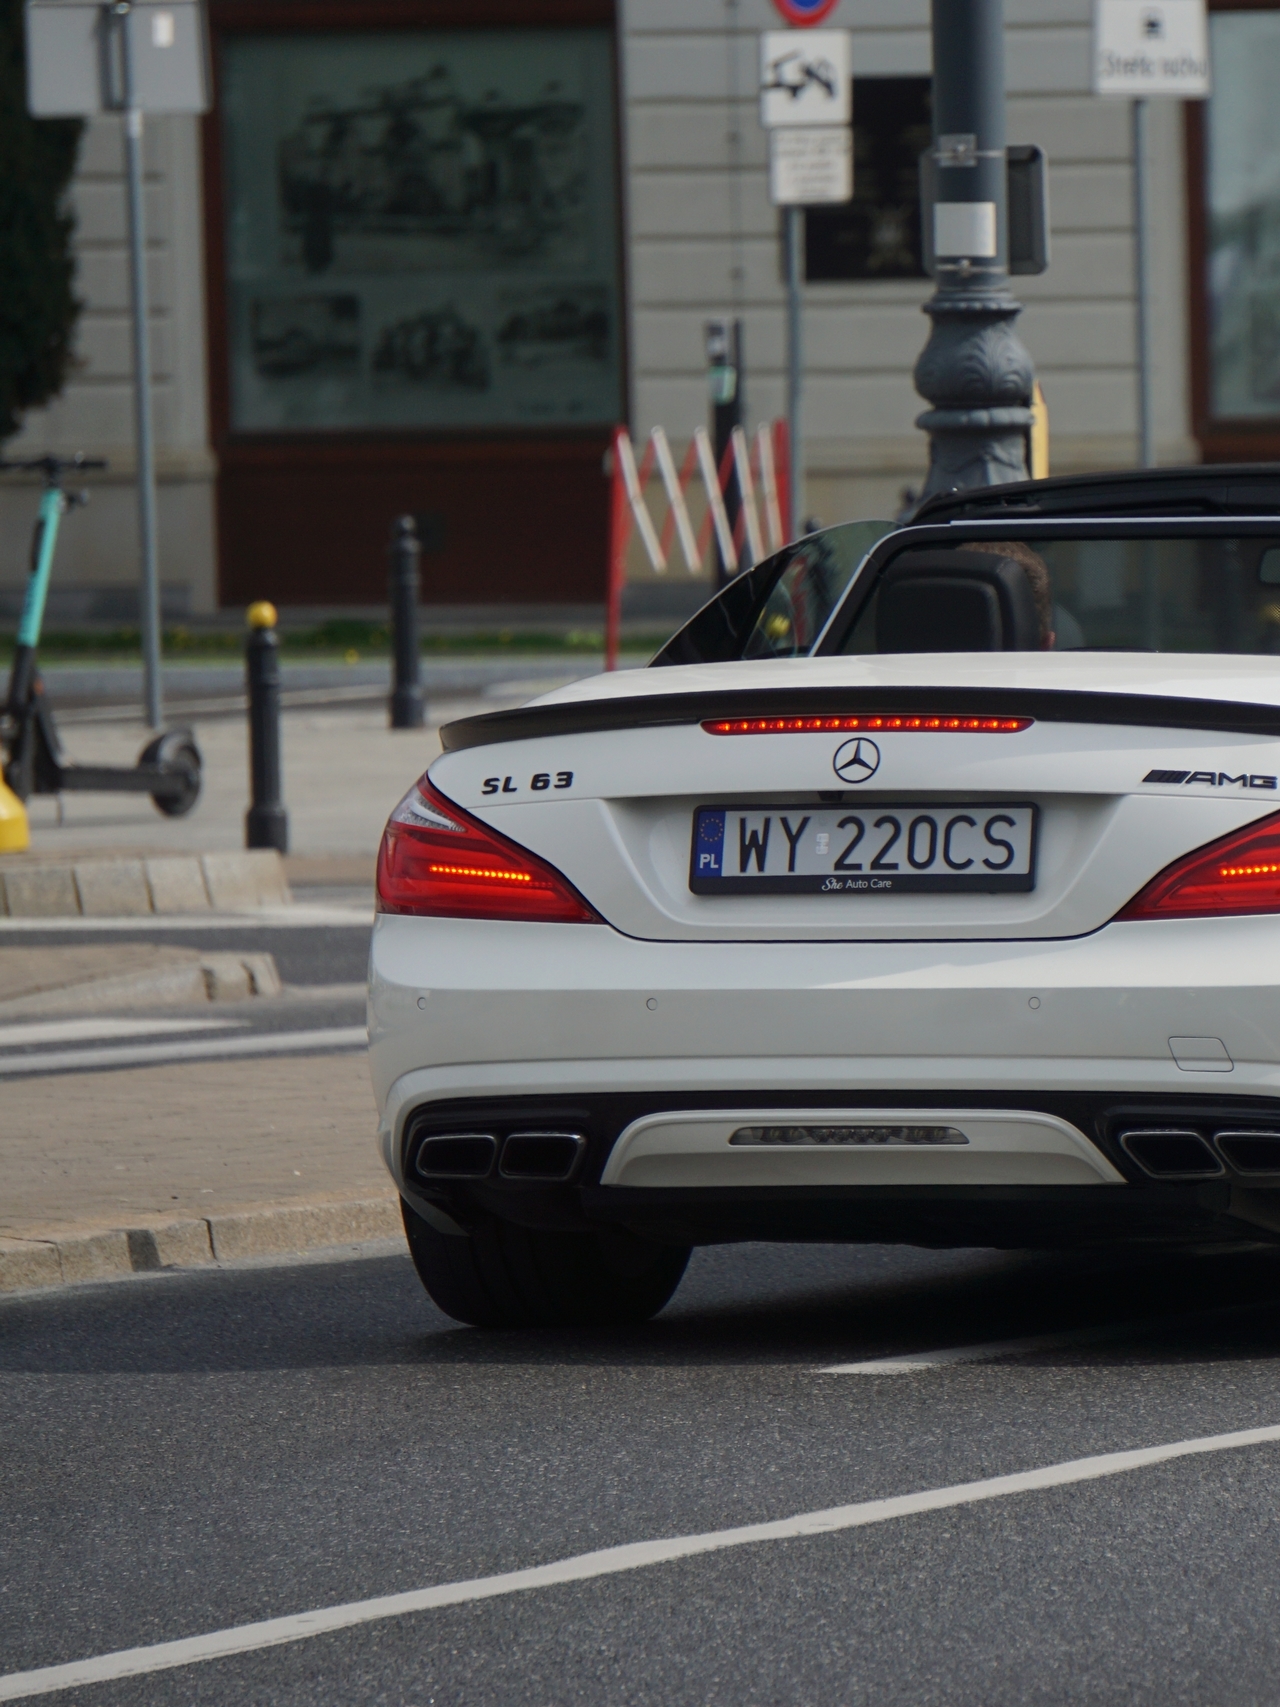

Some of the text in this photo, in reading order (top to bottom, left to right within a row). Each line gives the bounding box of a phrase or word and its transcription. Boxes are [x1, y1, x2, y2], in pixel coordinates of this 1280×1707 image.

[481, 771, 574, 795] SL 63
[1185, 771, 1278, 790] AMG
[739, 814, 1017, 874] WY 220CS
[699, 853, 719, 869] PL
[821, 877, 893, 892] She Auto Care
